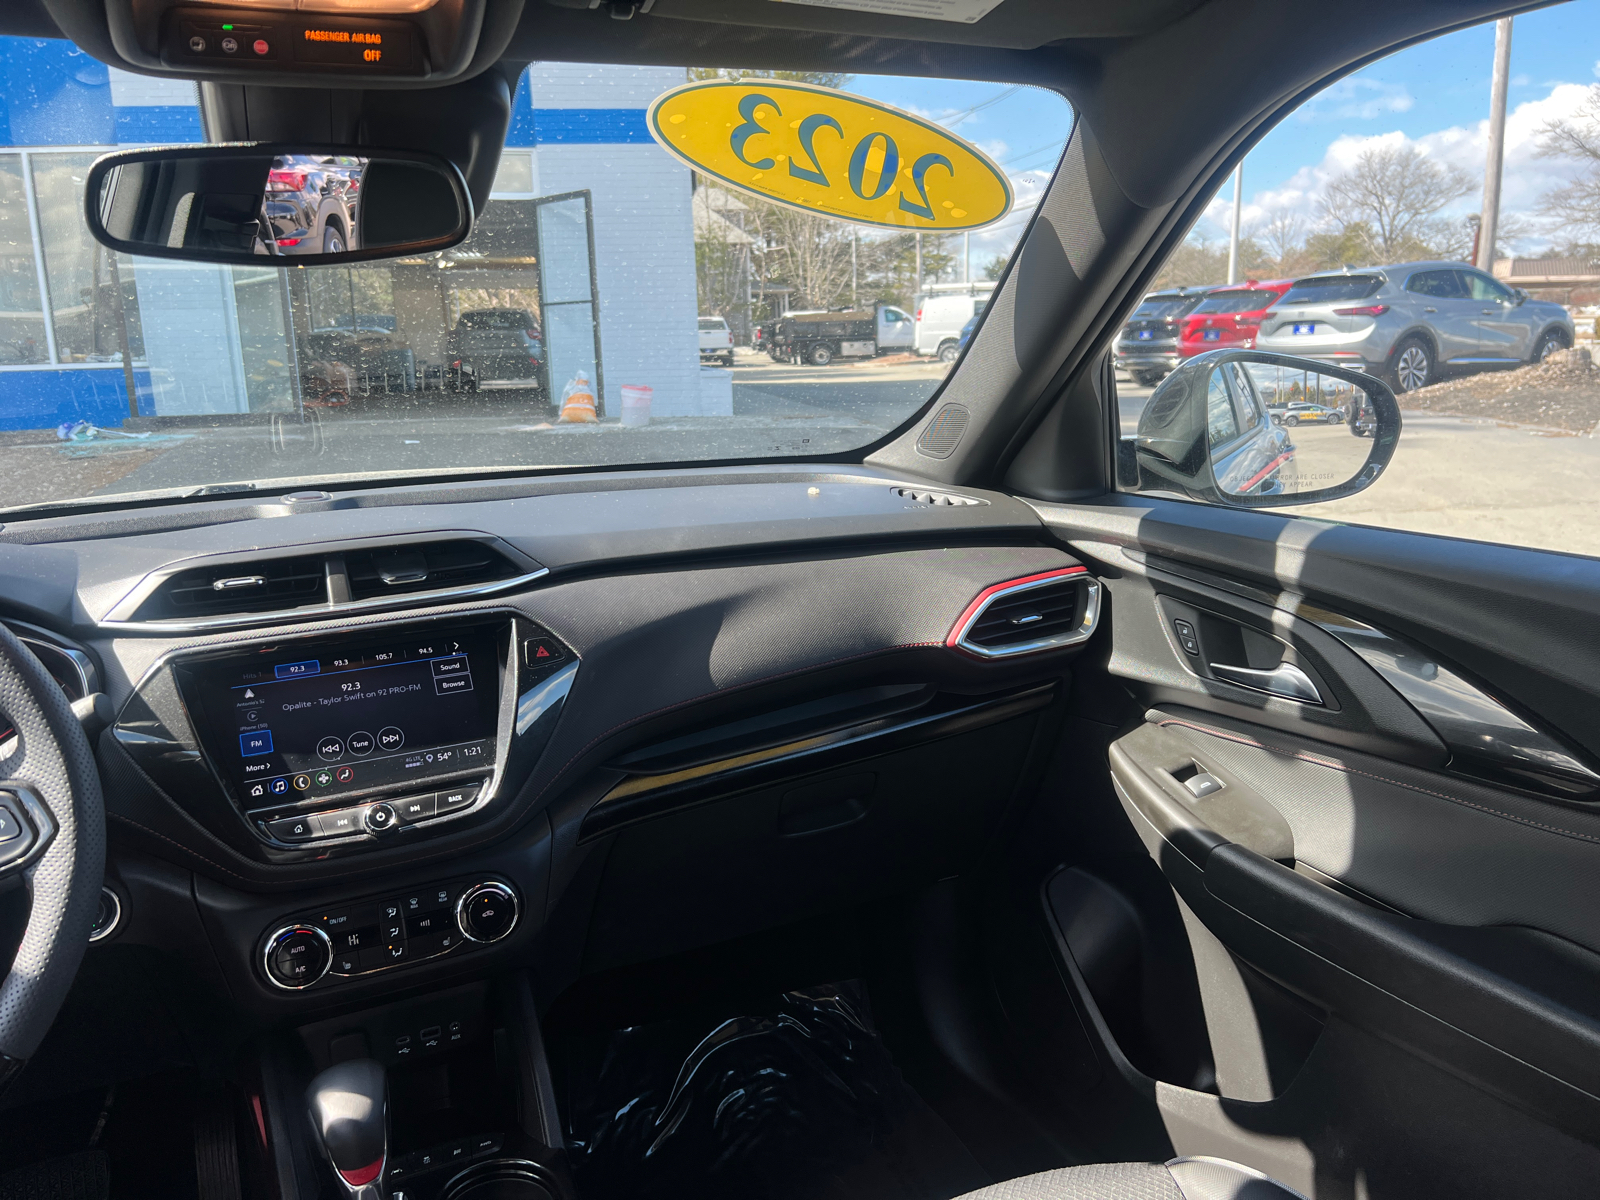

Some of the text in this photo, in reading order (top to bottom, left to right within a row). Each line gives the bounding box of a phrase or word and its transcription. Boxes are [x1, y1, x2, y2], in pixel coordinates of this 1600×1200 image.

[304, 30, 350, 42] PASSENGER
[363, 48, 382, 62] OFF
[418, 647, 433, 655] 94.5
[375, 652, 393, 661] 105.7
[333, 659, 349, 667] 93.3
[440, 662, 460, 671] Sound
[290, 665, 306, 673] 92.3
[242, 672, 257, 680] Hits
[341, 681, 361, 692] 92.3
[442, 680, 465, 689] Browse
[282, 700, 312, 712] Opalite
[318, 696, 342, 706] Taylor
[343, 692, 365, 702] Swift
[377, 689, 388, 697] 92
[389, 683, 422, 695] PRO-FM
[250, 739, 263, 748] FM
[352, 740, 369, 749] Tune
[463, 746, 482, 757] 1:21
[437, 751, 452, 762] 54°
[245, 763, 266, 773] More
[448, 795, 463, 803] BACK
[329, 915, 347, 925] ON/OFF
[348, 933, 360, 946] Hi
[290, 945, 306, 955] AUTO
[295, 965, 307, 974] A/C
[451, 1033, 462, 1041] AUX
